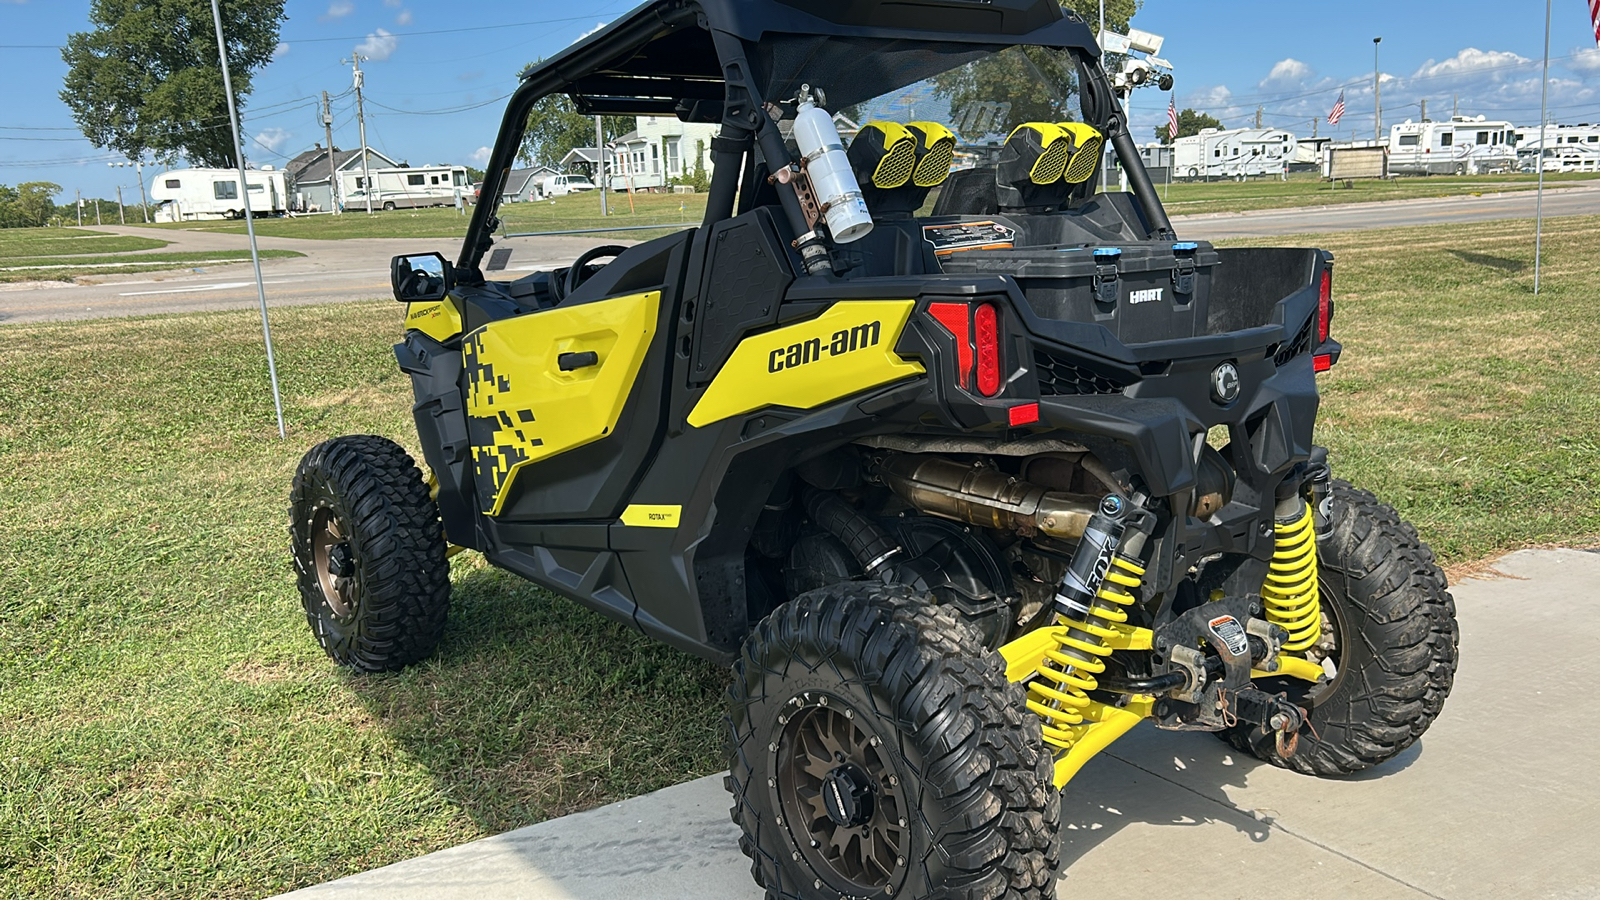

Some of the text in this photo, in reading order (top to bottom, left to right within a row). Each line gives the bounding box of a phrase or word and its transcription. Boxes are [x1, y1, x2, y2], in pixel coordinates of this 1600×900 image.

[1129, 287, 1164, 304] HART
[768, 320, 880, 373] can-am
[648, 513, 665, 521] ROTAX
[1085, 536, 1115, 598] FOX
